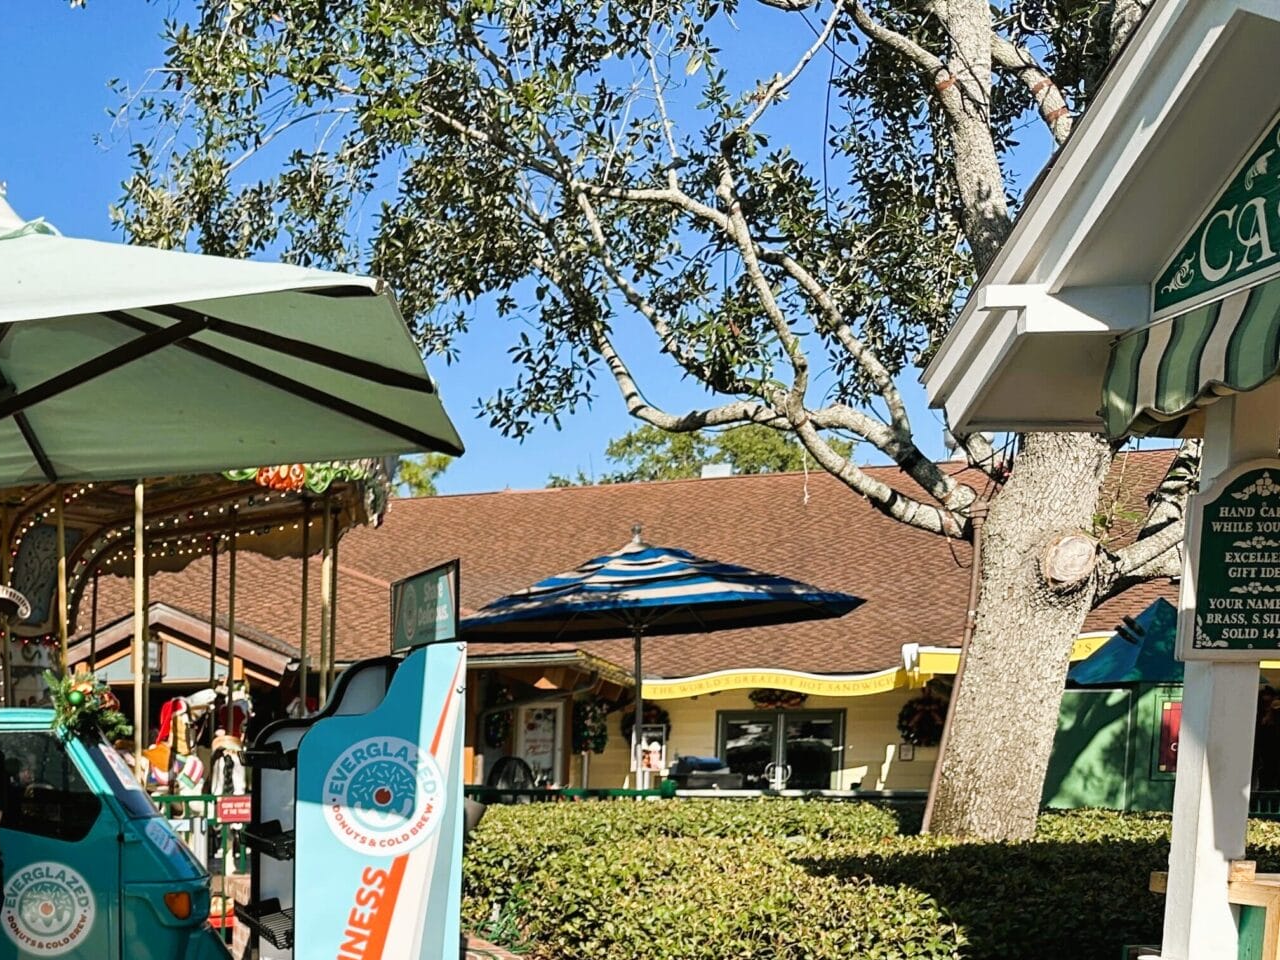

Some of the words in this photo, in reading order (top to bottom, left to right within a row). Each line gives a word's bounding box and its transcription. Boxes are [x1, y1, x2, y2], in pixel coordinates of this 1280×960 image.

[1199, 196, 1280, 283] CA
[1219, 506, 1255, 518] HAND
[1211, 521, 1254, 533] WHILE
[1224, 552, 1280, 563] EXCELLE
[1228, 567, 1258, 578] GIFT
[1208, 598, 1243, 609] YOUR
[1206, 613, 1248, 625] BRASS,
[1221, 628, 1259, 639] SOLID
[800, 681, 822, 690] HOT
[328, 741, 436, 796] EVERGLAZED
[332, 804, 367, 844] DONUTS
[368, 838, 376, 847] &
[379, 833, 410, 847] COLD
[410, 802, 434, 836] BREW
[4, 866, 90, 909] EVERGLAZED
[7, 915, 37, 947] DONUTS
[45, 937, 70, 949] COLD
[69, 914, 87, 940] BREW
